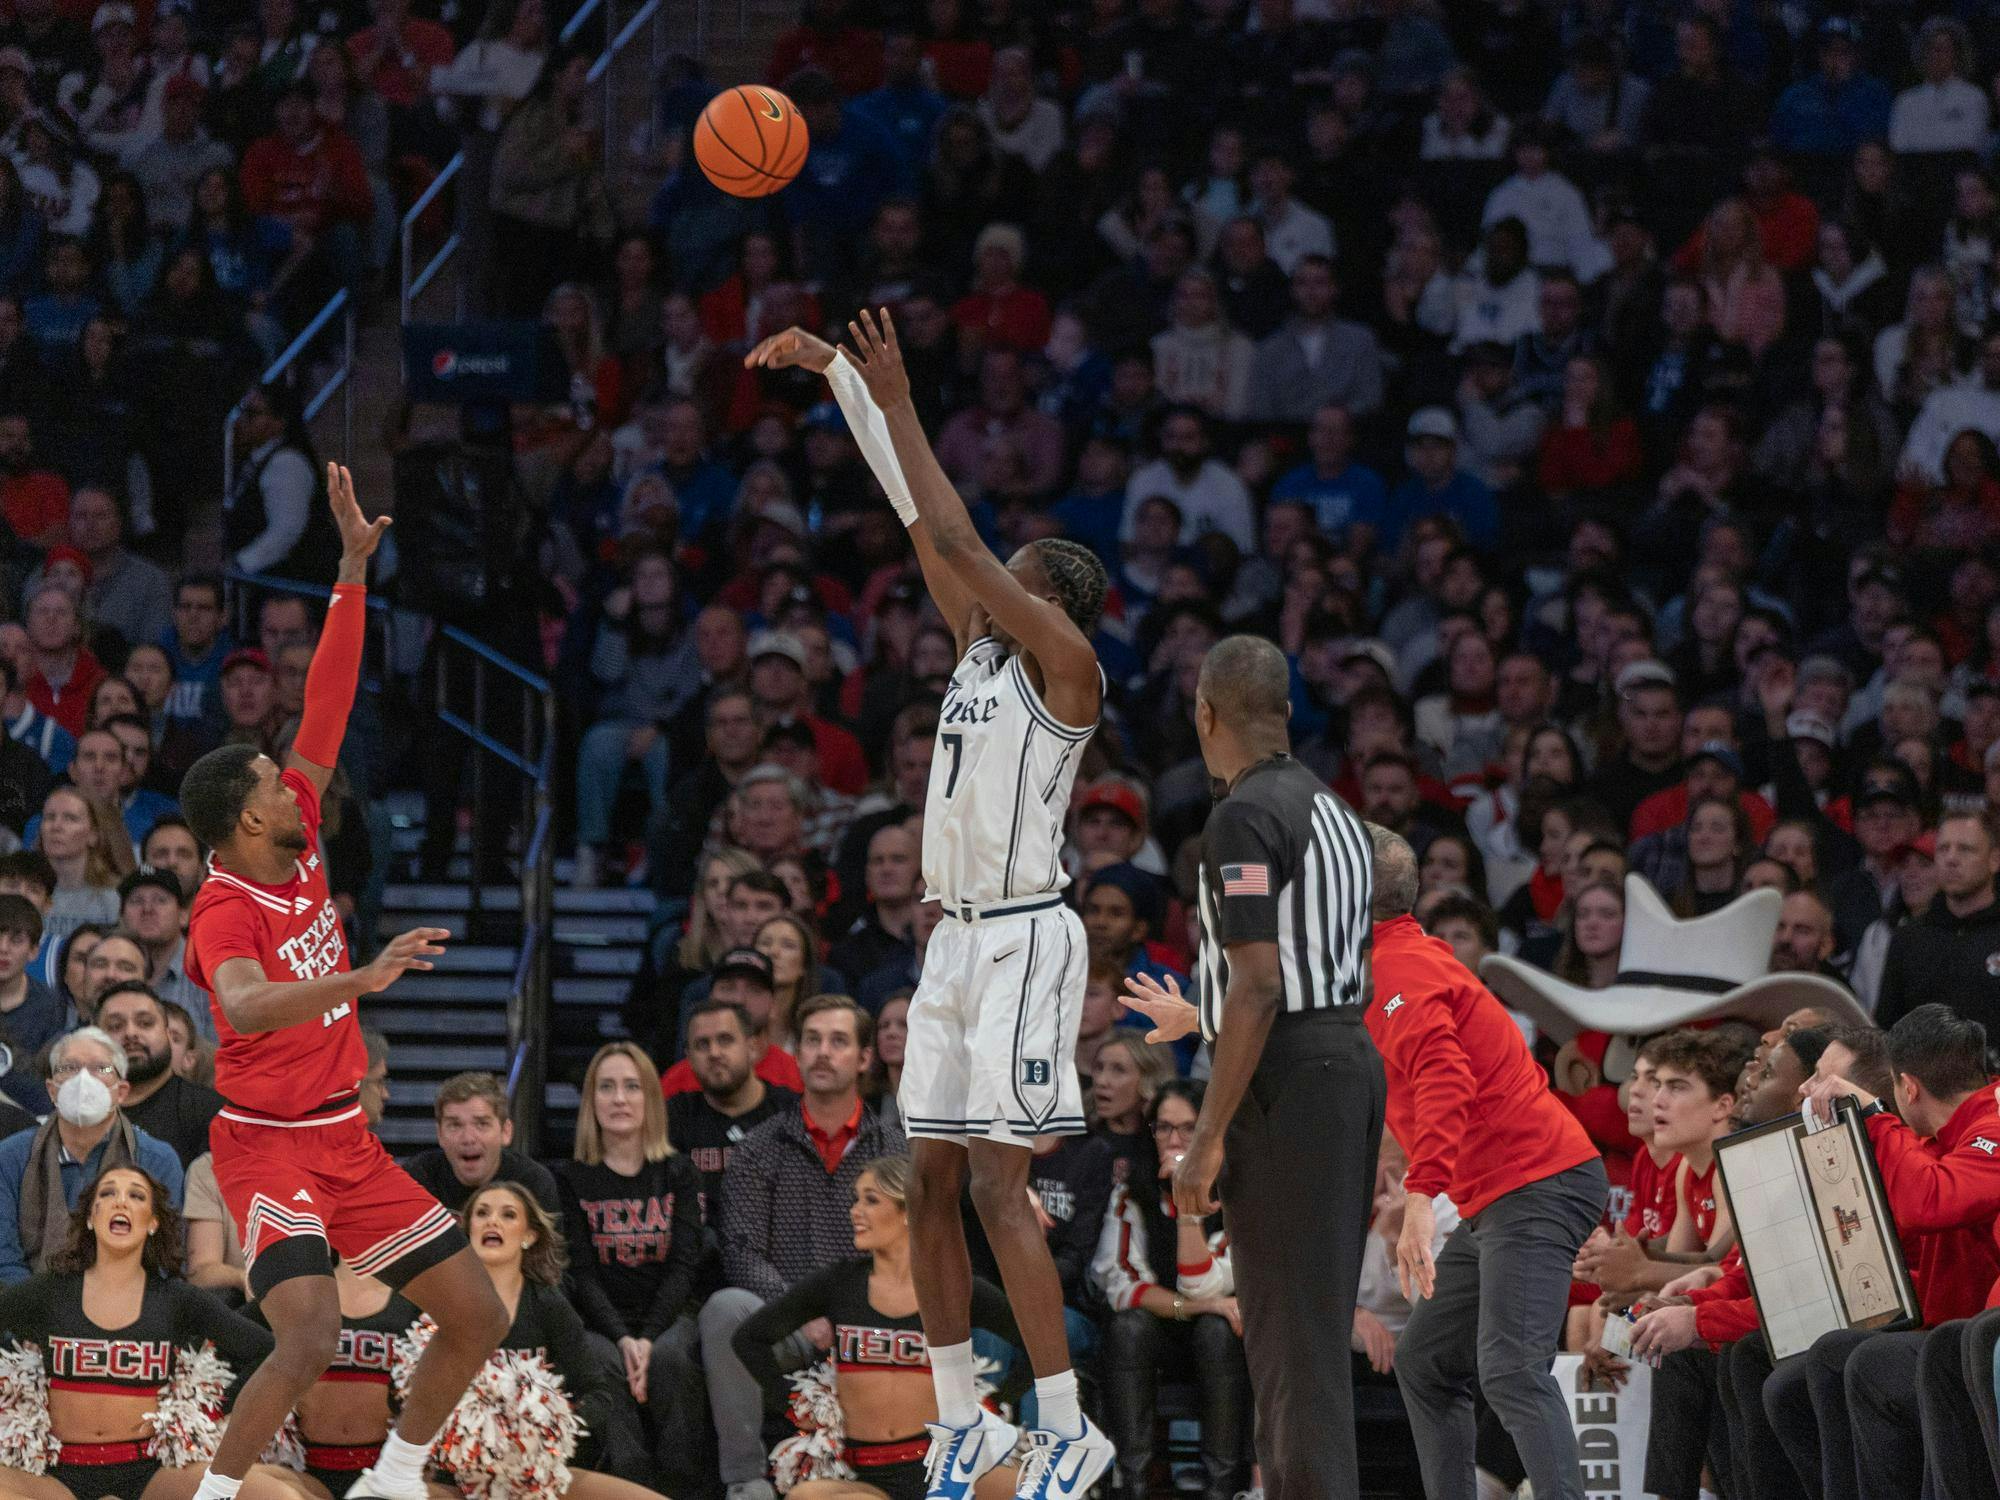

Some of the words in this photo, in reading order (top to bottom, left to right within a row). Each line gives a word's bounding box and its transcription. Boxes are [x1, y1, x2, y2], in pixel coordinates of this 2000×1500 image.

[941, 733, 963, 799] 7
[276, 898, 337, 972] TEXAS
[294, 929, 345, 981] TECH
[48, 1335, 171, 1380] TECH
[837, 1324, 931, 1367] TEC
